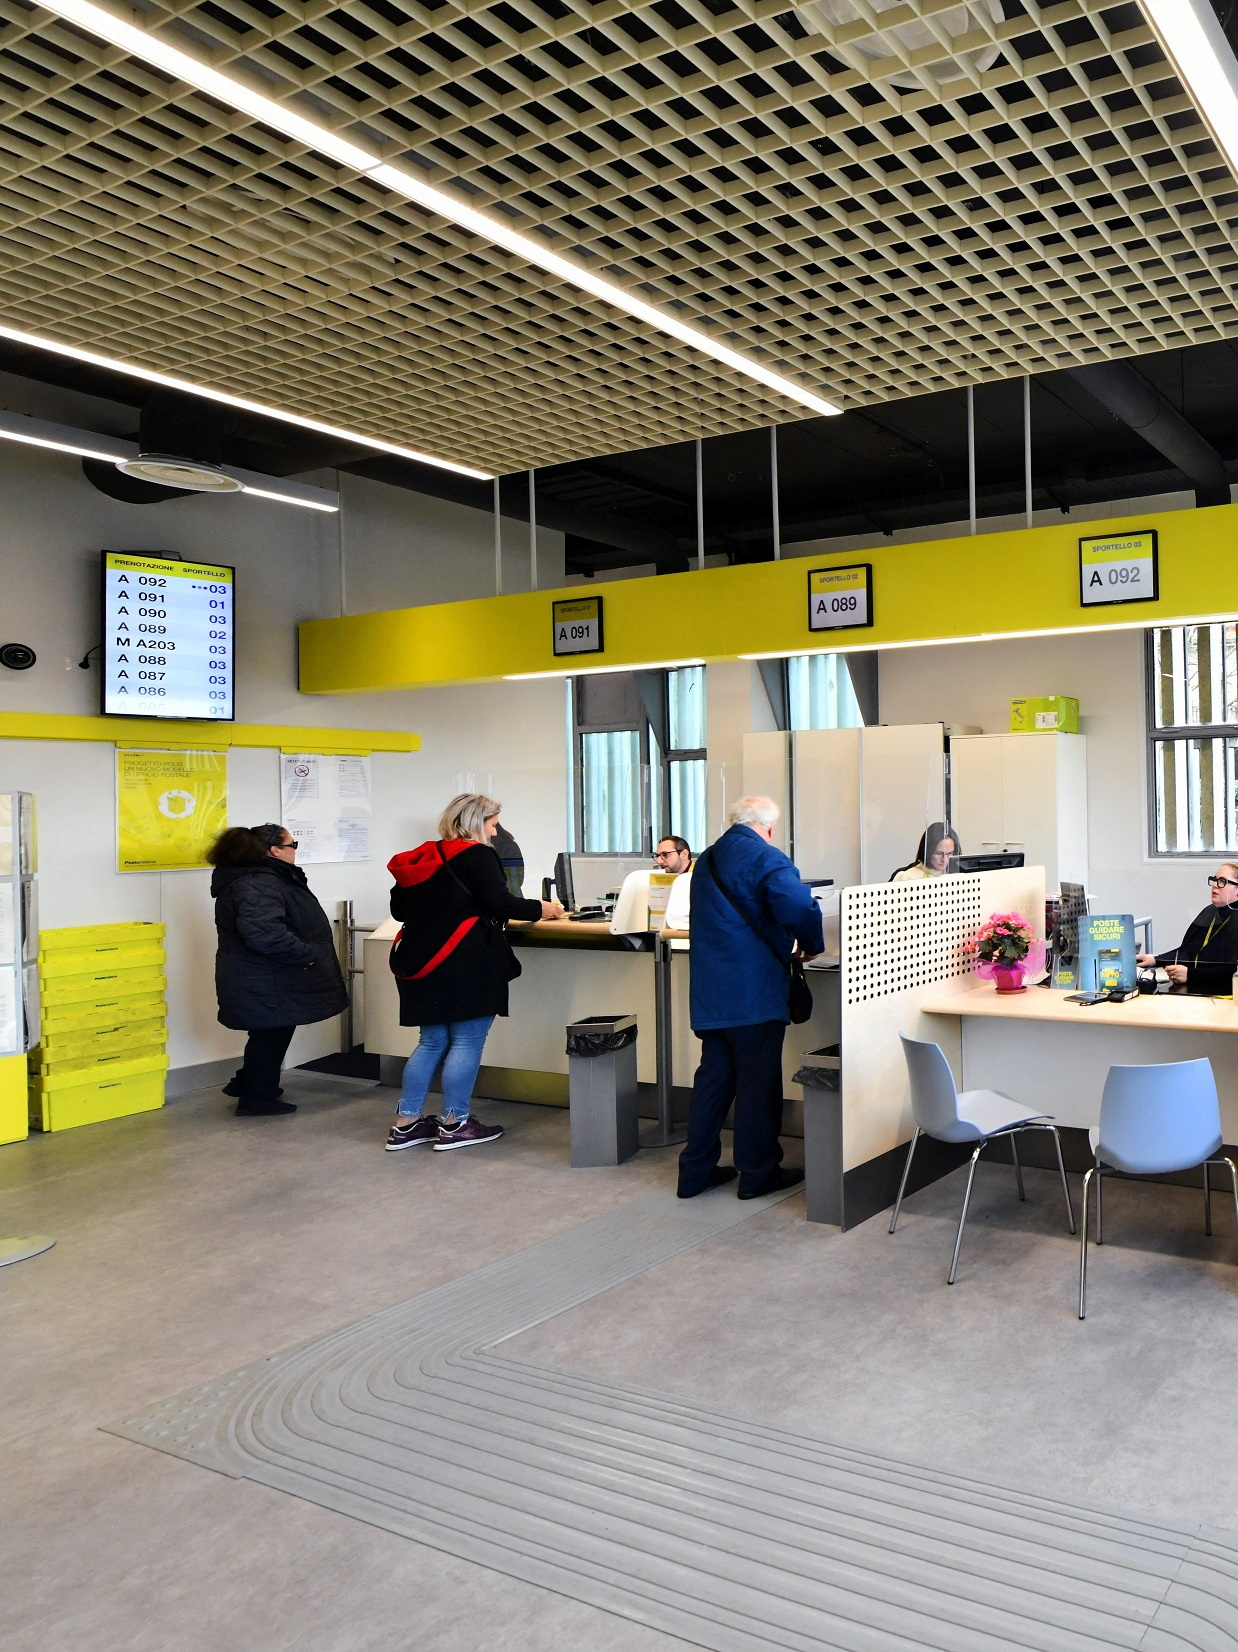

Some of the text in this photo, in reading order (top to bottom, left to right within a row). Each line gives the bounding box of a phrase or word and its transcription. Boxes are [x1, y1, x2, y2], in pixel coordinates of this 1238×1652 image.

[1092, 542, 1133, 553] SPORTELLO
[114, 559, 226, 578] PRENOTAZIONE SPORTELLO
[1089, 566, 1141, 587] A 092
[117, 574, 227, 594] A 092 03
[818, 574, 851, 583] SPORTELLO
[117, 590, 225, 610] A 091 01
[816, 596, 857, 614] A 089
[117, 606, 227, 625] A 090 03
[117, 622, 227, 640] A 089 02
[559, 625, 590, 640] A 091
[116, 637, 227, 655] M A203 03
[117, 654, 227, 670] A 088 03
[117, 670, 227, 685] A 087 03
[117, 685, 227, 700] A 086 03
[209, 706, 225, 715] 01
[1089, 926, 1125, 934] GUIDARE
